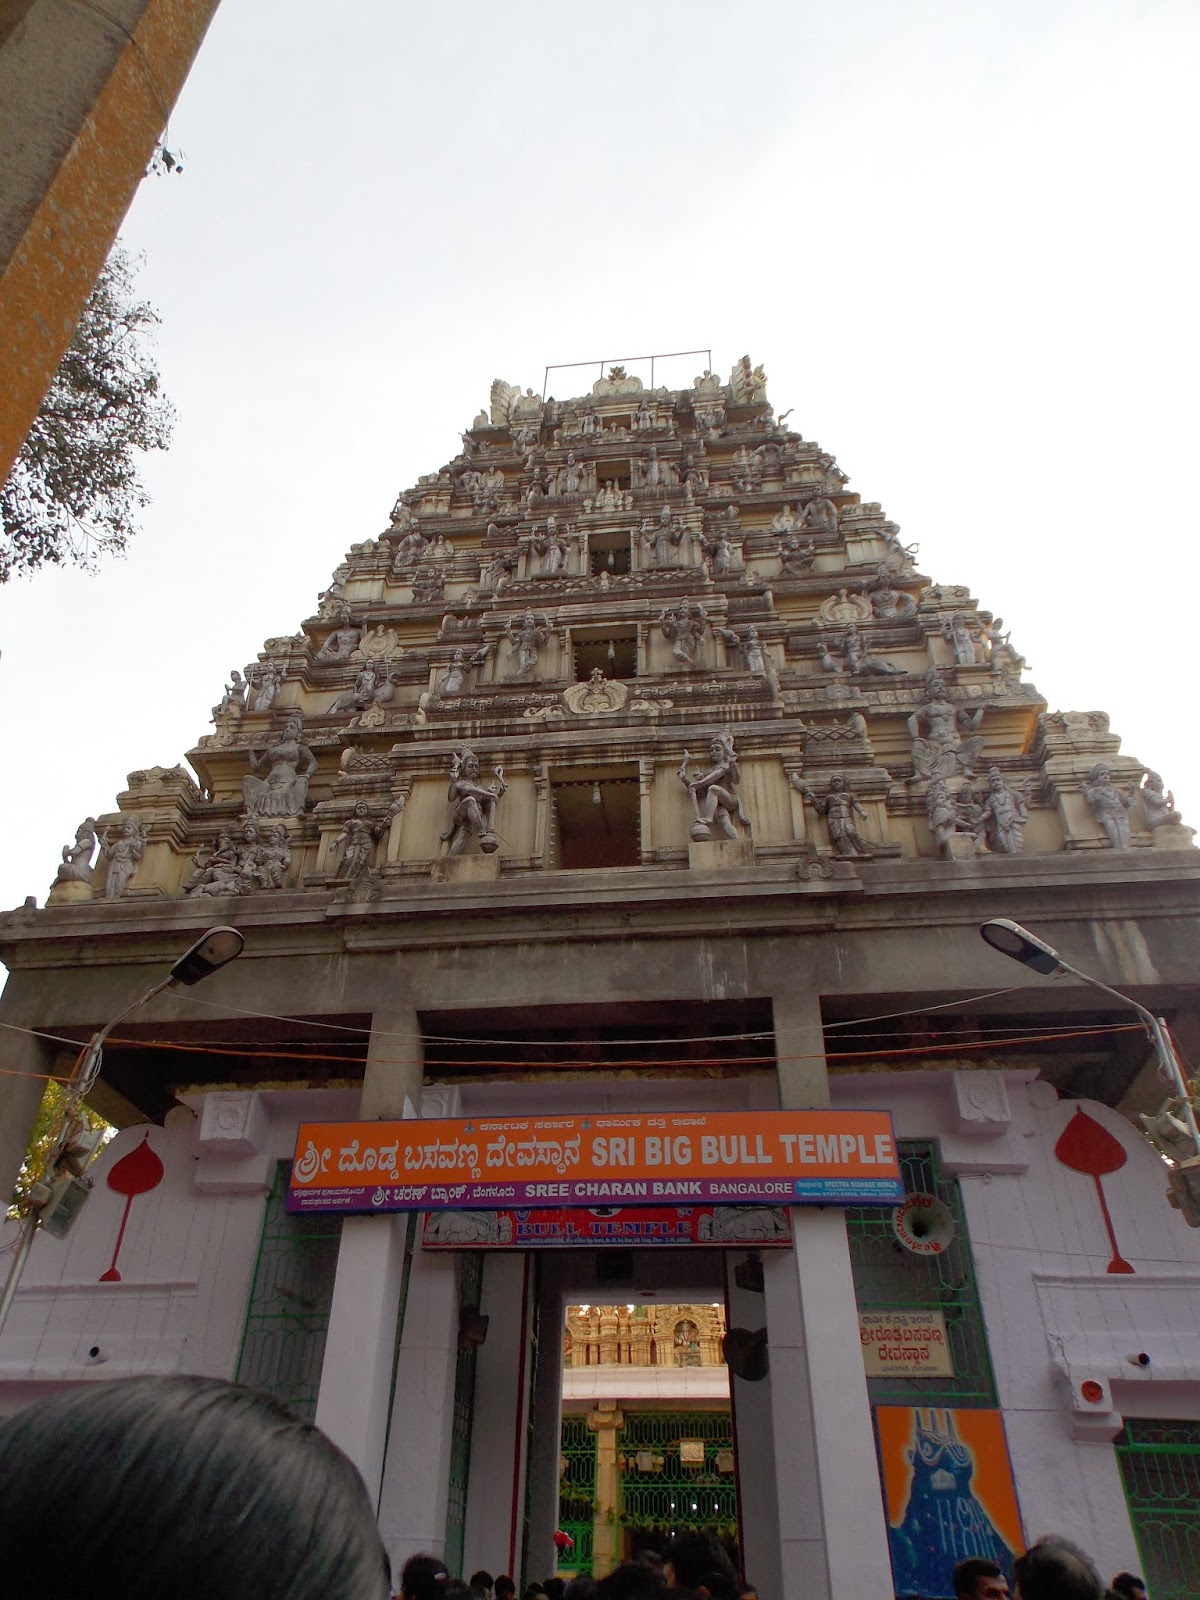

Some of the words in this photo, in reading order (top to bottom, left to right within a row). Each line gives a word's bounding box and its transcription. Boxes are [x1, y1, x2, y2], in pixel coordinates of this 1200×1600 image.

[479, 1121, 529, 1132] ಕರ್ನಾಟಕ
[534, 1119, 575, 1130] ಸರ್ಕಾರ
[294, 1140, 332, 1183] ಶ್ರೀ
[338, 1139, 400, 1181] ದೊಡ್ಡ
[404, 1137, 482, 1179] ಬಸವಣ್ಣ
[485, 1133, 582, 1175] ದೇವಸ್ಥಾನ
[591, 1136, 635, 1166] SRI
[645, 1136, 691, 1166] BIG
[701, 1134, 773, 1165] BULL
[779, 1133, 895, 1164] TEMPLE
[371, 1185, 390, 1206] ಶ್ರೀ
[393, 1185, 428, 1201] ಚರಣ್
[473, 1185, 516, 1198] ಬೆಂಗಳೂರು
[525, 1183, 569, 1197] SREE
[574, 1182, 647, 1196] CHARAN
[653, 1181, 702, 1195] BANK
[709, 1182, 793, 1194] BANGALORE
[516, 1222, 581, 1236] BULL
[588, 1221, 693, 1235] TEMPLE
